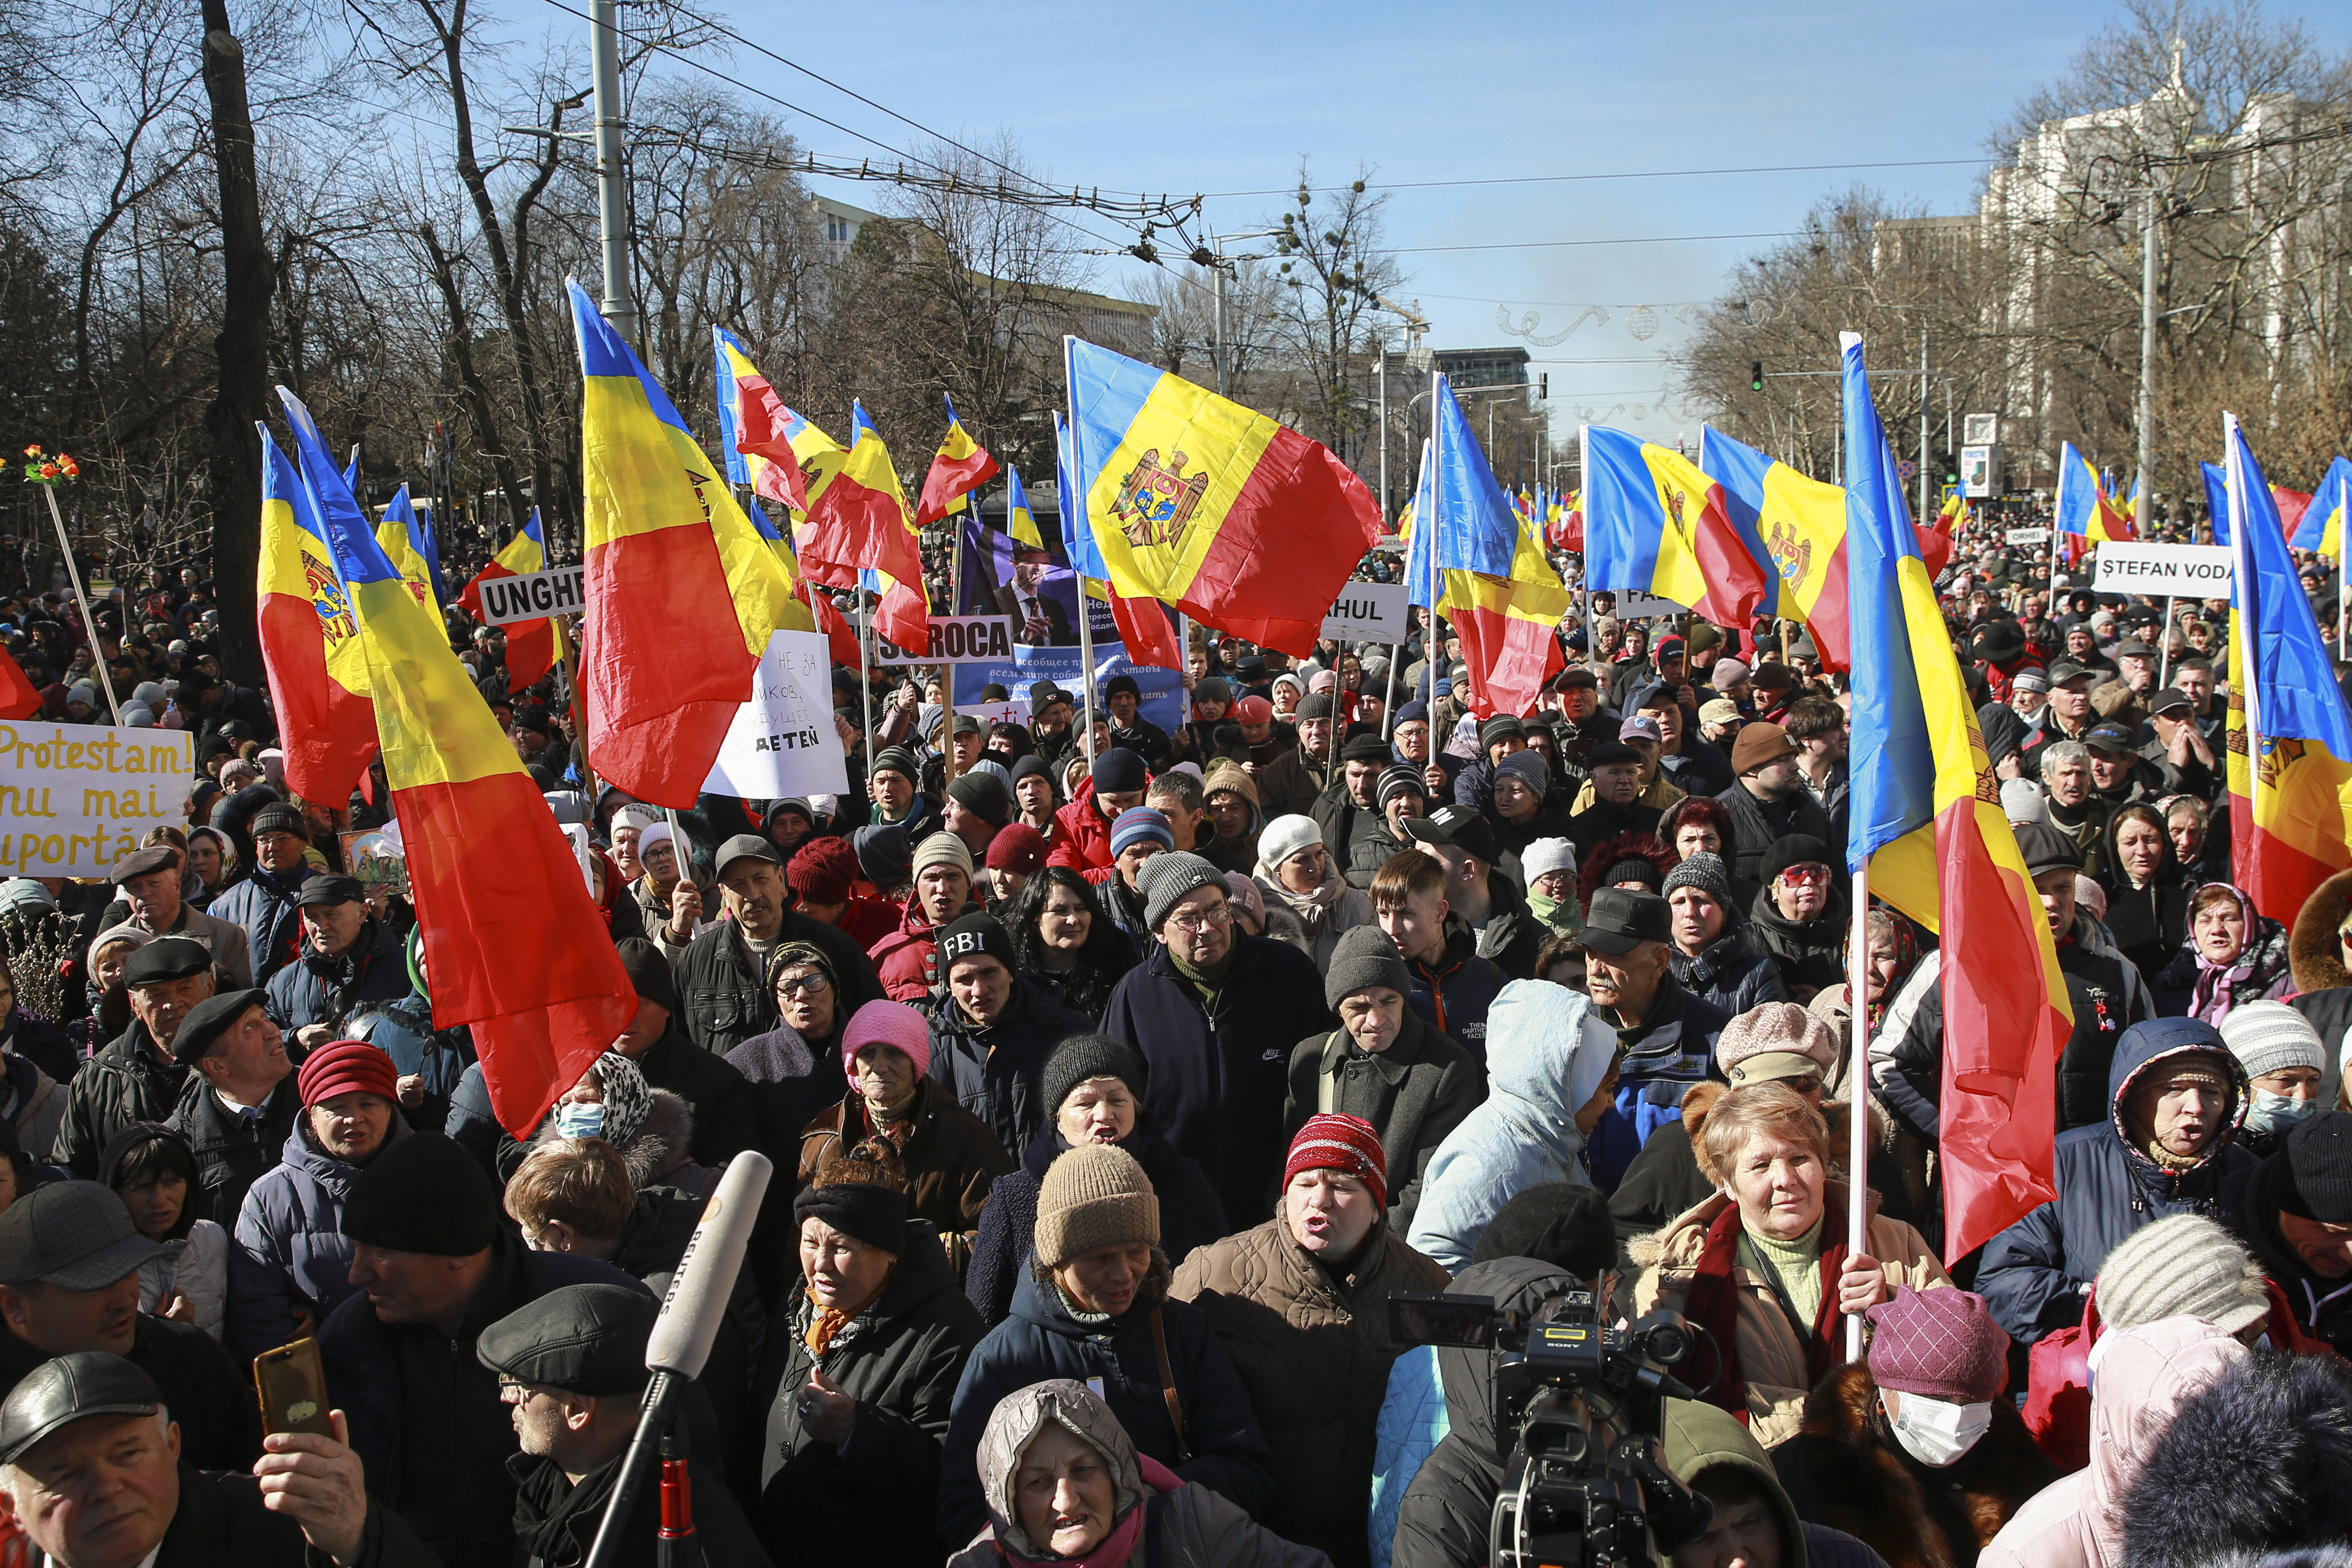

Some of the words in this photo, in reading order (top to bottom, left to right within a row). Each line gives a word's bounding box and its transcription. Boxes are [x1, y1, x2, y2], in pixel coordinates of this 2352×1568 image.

[2102, 559, 2177, 579] ȘTEFAN
[778, 651, 794, 670] НЕ
[803, 653, 816, 676] ЗА
[990, 669, 1018, 678] всем
[1020, 671, 1049, 681] мире
[1122, 665, 1161, 674] чтобы
[1016, 657, 1068, 668] всеобщее
[756, 725, 819, 752] ДЕТЕЙ
[0, 785, 57, 818] nu
[83, 784, 167, 820] mai
[944, 932, 985, 961] FBI
[1265, 1048, 1280, 1057] NIKE
[660, 1231, 703, 1315] REUTERS
